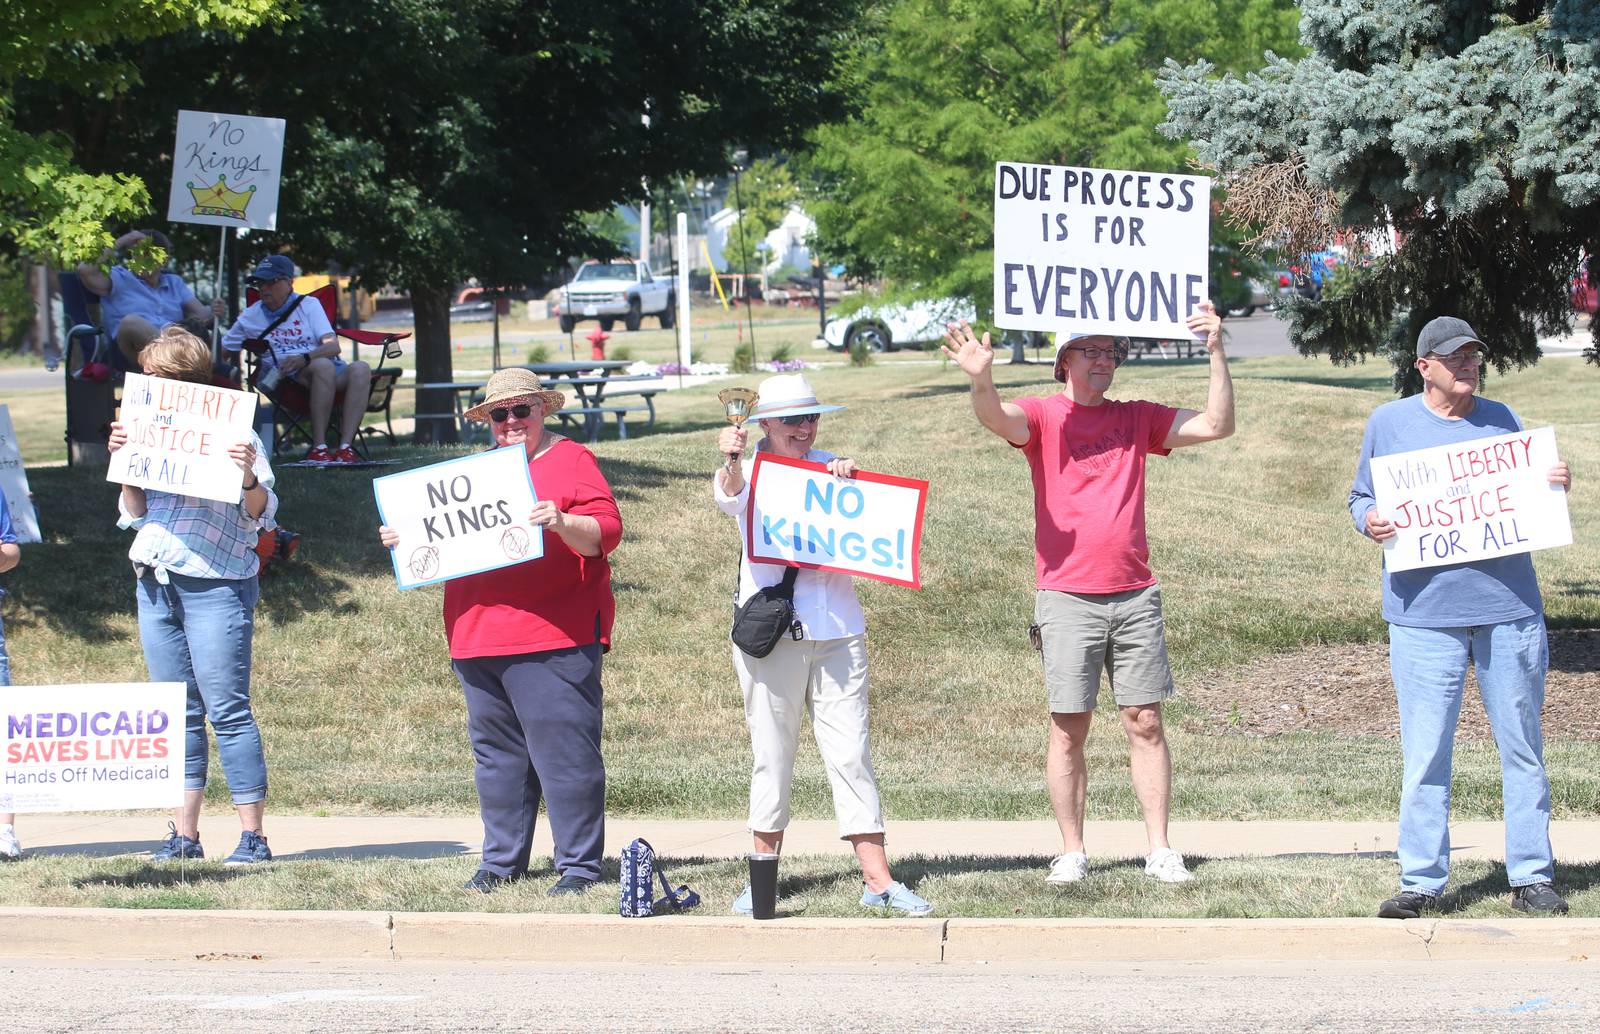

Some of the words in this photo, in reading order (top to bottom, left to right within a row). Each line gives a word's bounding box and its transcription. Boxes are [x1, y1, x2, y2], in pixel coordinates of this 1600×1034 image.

[184, 142, 271, 181] Kings
[999, 165, 1052, 201] DUE
[1063, 169, 1195, 213] PROCESS
[1041, 212, 1069, 243] IS
[1094, 215, 1147, 247] FOR
[153, 412, 173, 426] and
[159, 382, 241, 424] LIBERTY
[127, 452, 152, 481] FOR
[158, 457, 193, 486] ALL
[1387, 459, 1438, 490] With
[1447, 435, 1533, 482] LIBERTY
[426, 474, 472, 509] NO
[804, 478, 865, 519] NO
[1446, 479, 1472, 498] and
[422, 499, 513, 543] KINGS
[763, 514, 905, 570] KINGS!
[1418, 529, 1468, 562] FOR
[1482, 518, 1529, 551] ALL
[7, 709, 169, 739] MEDICAID
[7, 740, 89, 764] SAVES
[95, 737, 169, 761] LIVES
[5, 768, 57, 785] Hands
[61, 767, 88, 783] Off
[92, 765, 169, 782] Medicaid
